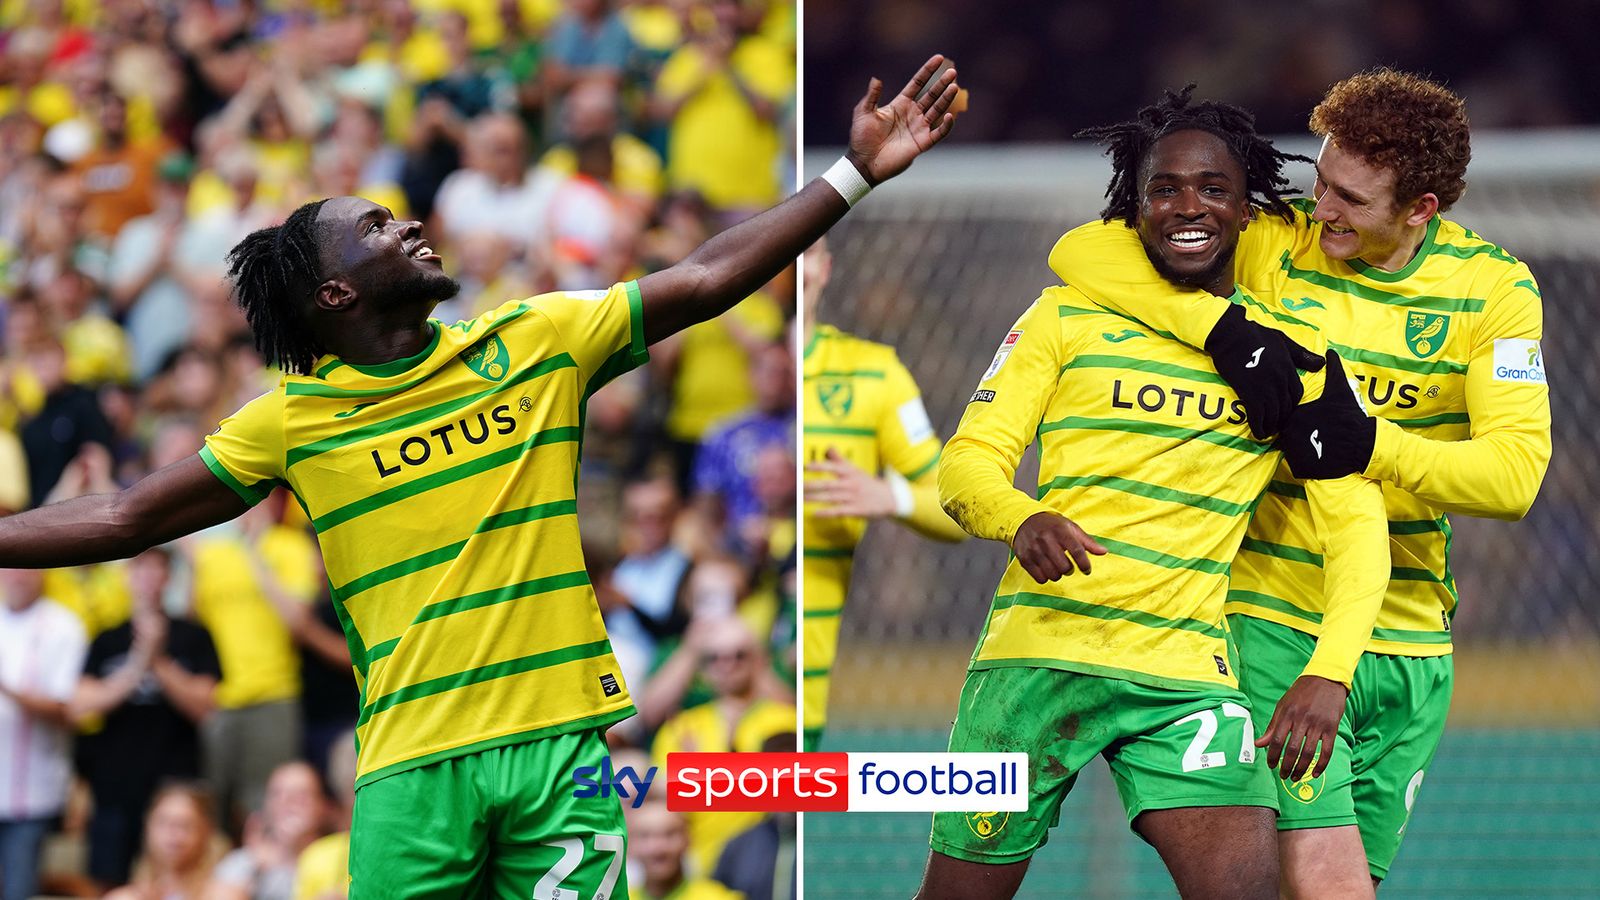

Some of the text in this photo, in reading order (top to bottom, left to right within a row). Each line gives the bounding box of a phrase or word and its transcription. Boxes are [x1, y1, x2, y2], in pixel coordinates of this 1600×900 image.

[1111, 379, 1248, 425] LOTUS
[1354, 374, 1421, 409] US
[371, 404, 517, 479] LOTUS
[1174, 702, 1255, 773] 27
[532, 833, 624, 900] 27
